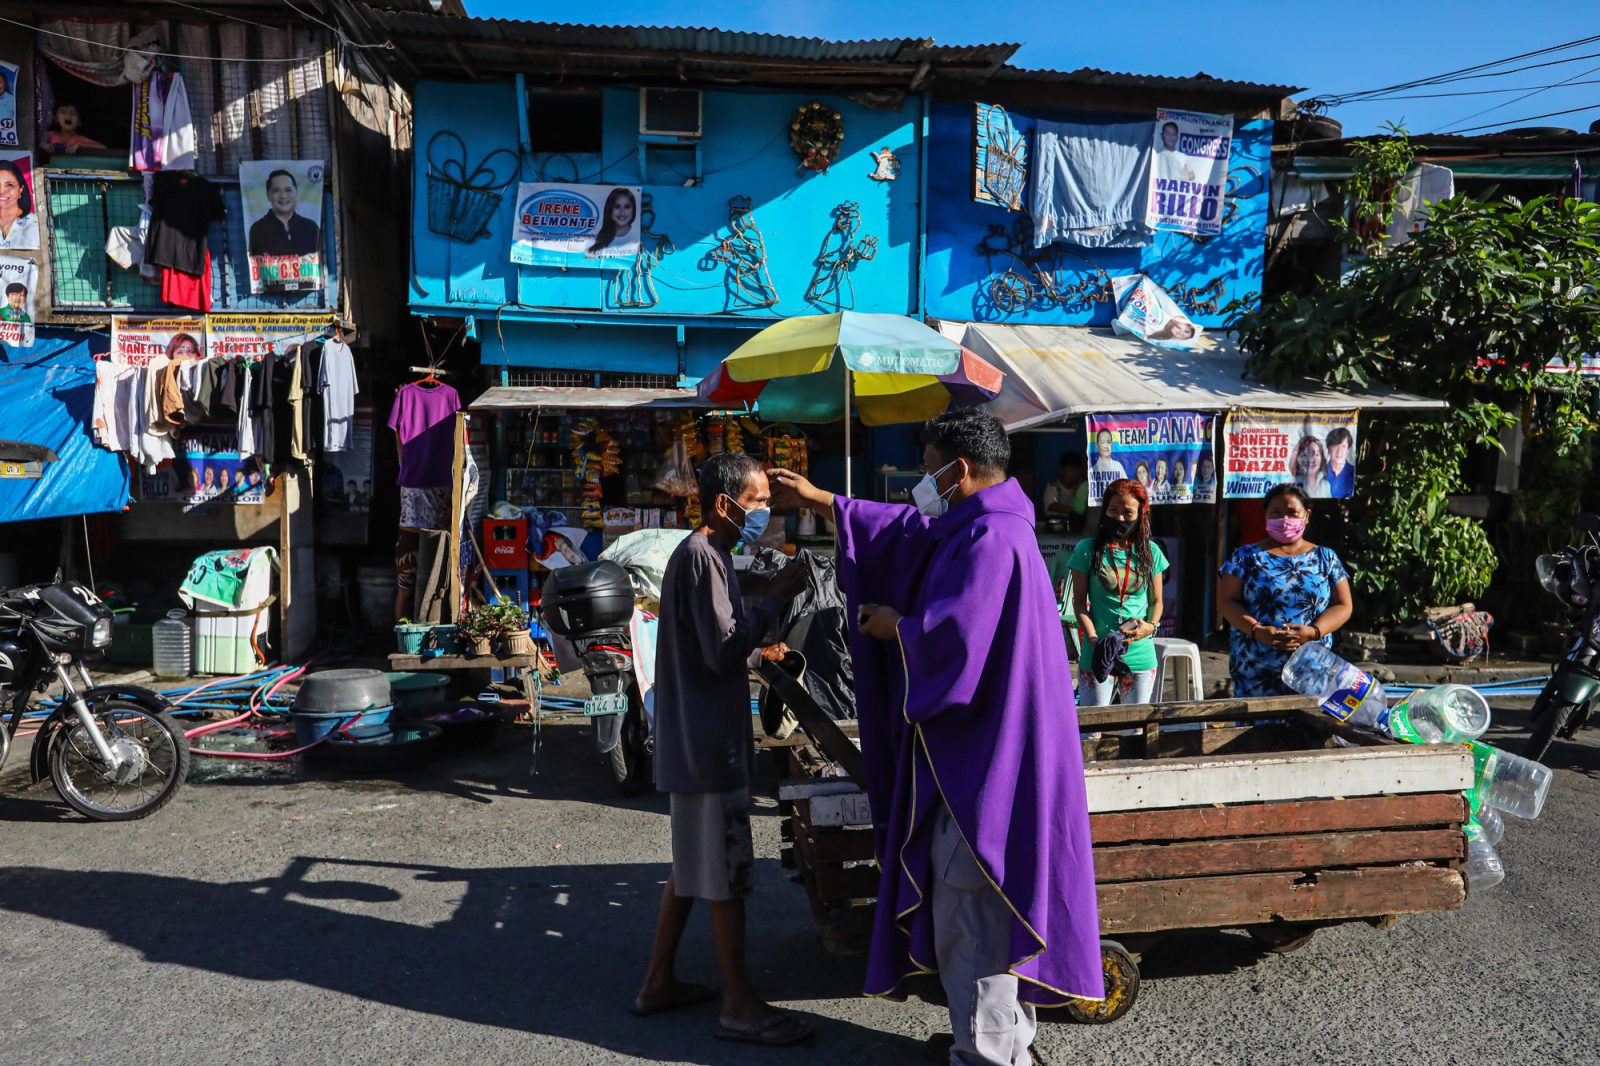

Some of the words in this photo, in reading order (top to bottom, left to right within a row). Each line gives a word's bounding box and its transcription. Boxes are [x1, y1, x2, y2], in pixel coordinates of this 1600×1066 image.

[1180, 136, 1228, 158] CONGRESS
[1156, 178, 1220, 197] MARVIN
[537, 202, 580, 215] IRENE
[1151, 192, 1218, 221] RILLO
[521, 215, 595, 228] BELMONTE
[118, 334, 150, 342] COUNCILOR
[1118, 428, 1147, 445] TEAM
[1229, 433, 1288, 446] NANETTE
[1229, 446, 1288, 458] CASTELO
[1229, 459, 1286, 472] DAZA
[1090, 471, 1120, 481] MARVIN
[142, 481, 169, 497] RILLO
[1226, 481, 1262, 494] WINNIE
[494, 546, 515, 554] Coca-Cola
[614, 698, 625, 711] XJ
